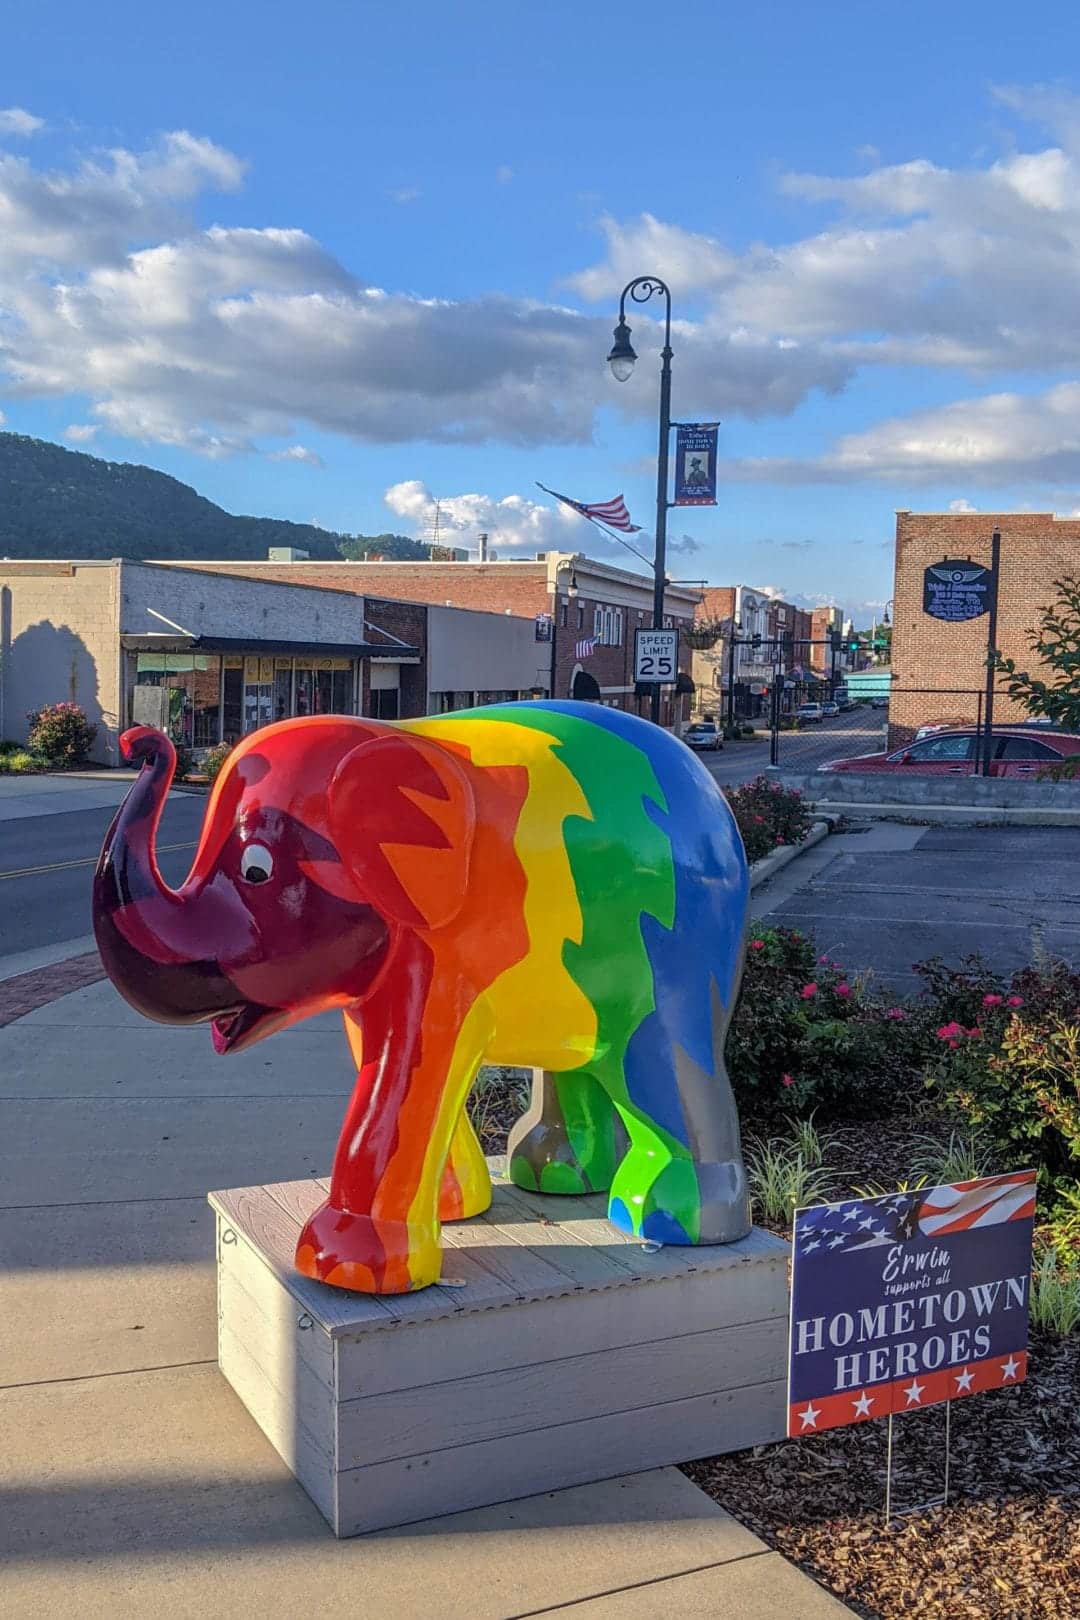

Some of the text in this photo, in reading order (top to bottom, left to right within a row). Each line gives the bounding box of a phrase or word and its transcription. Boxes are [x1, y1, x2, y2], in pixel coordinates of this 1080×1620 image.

[640, 636, 674, 645] SPEED
[643, 647, 669, 655] LIMIT
[640, 657, 672, 676] 25
[882, 1244, 950, 1282] Erwin
[883, 1269, 951, 1296] supports all
[794, 1275, 1028, 1355] HOMETOWN
[832, 1325, 991, 1391] HEROES
